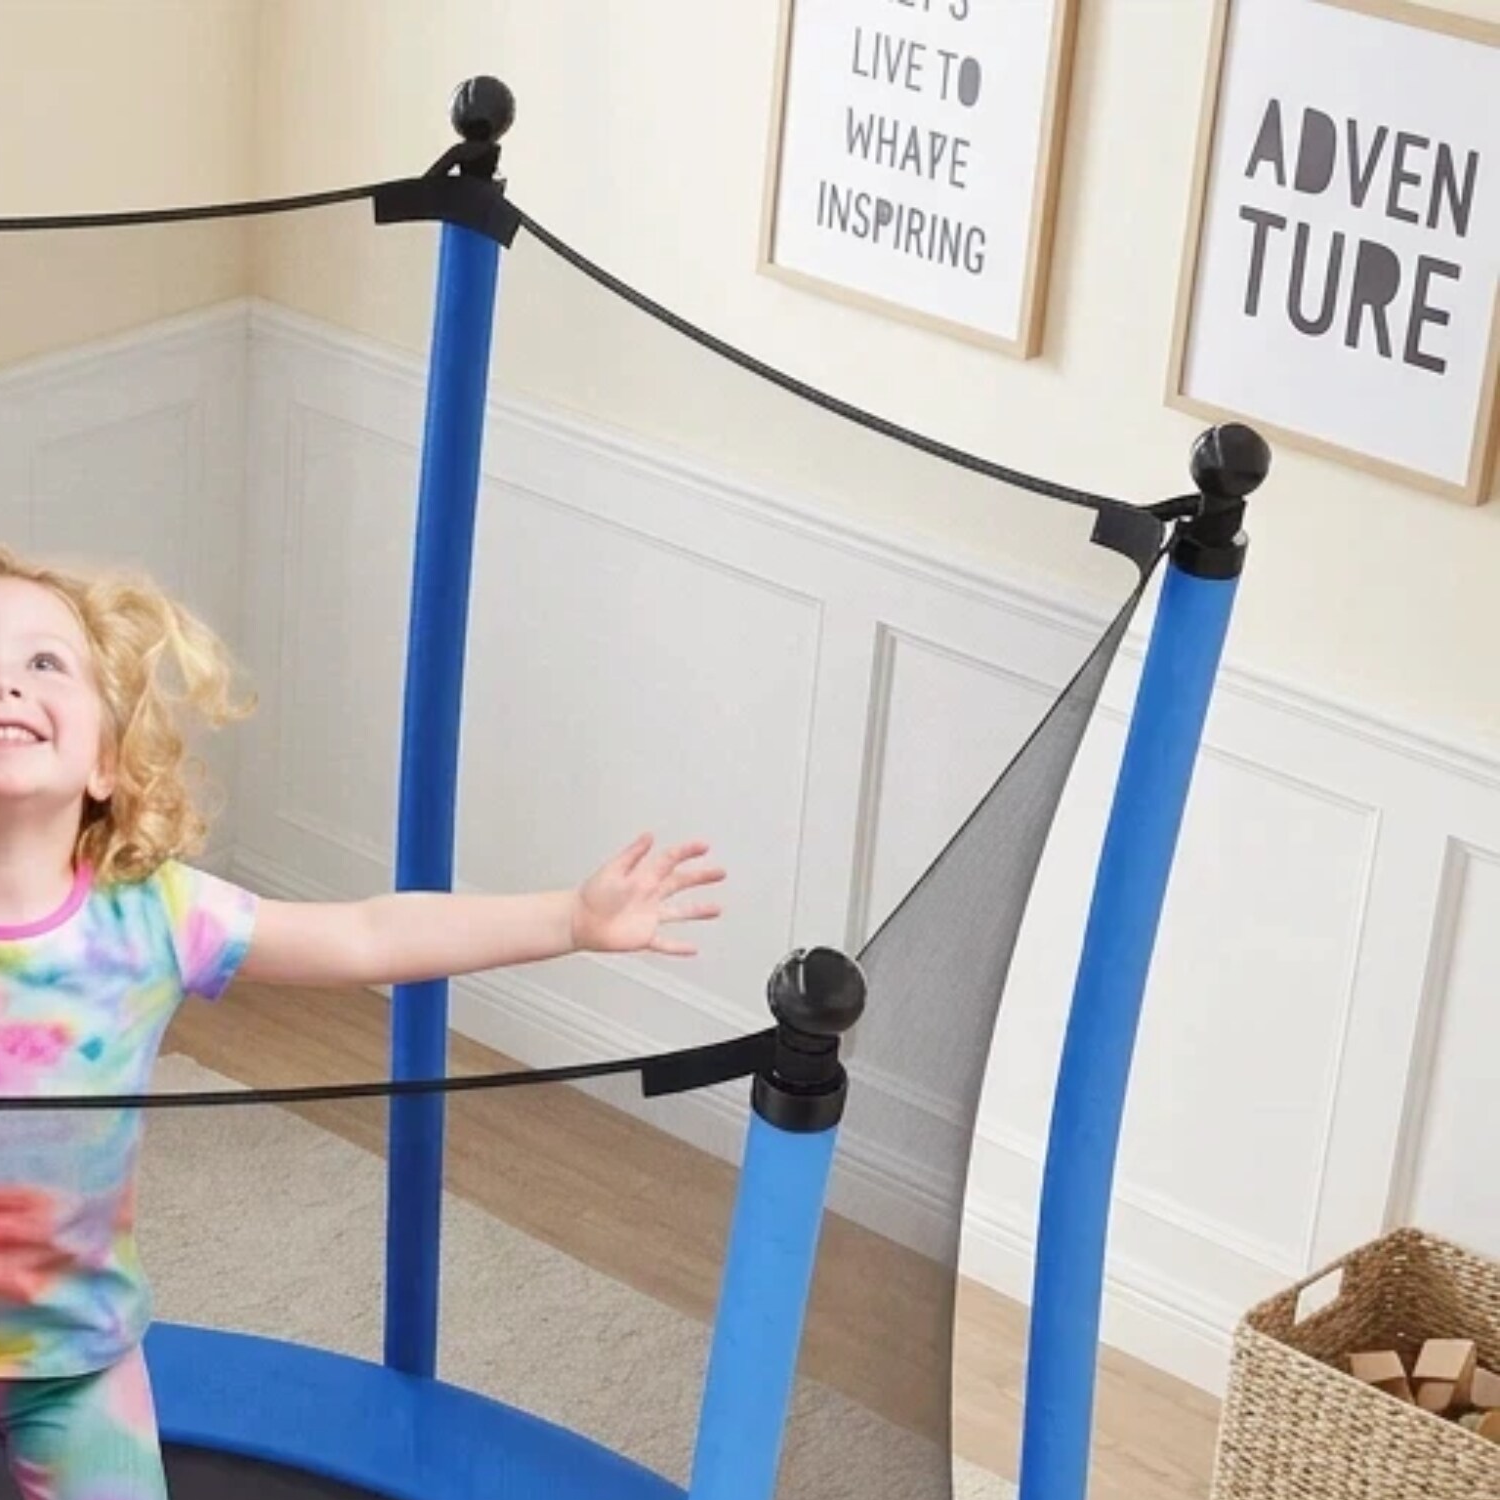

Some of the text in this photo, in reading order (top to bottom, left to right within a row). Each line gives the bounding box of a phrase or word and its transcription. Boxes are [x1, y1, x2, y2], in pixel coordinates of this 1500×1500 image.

[852, 27, 981, 107] LIVE TO
[1244, 98, 1479, 238] ADVEN
[816, 180, 986, 275] INSPIRING
[1239, 205, 1461, 375] TURE
